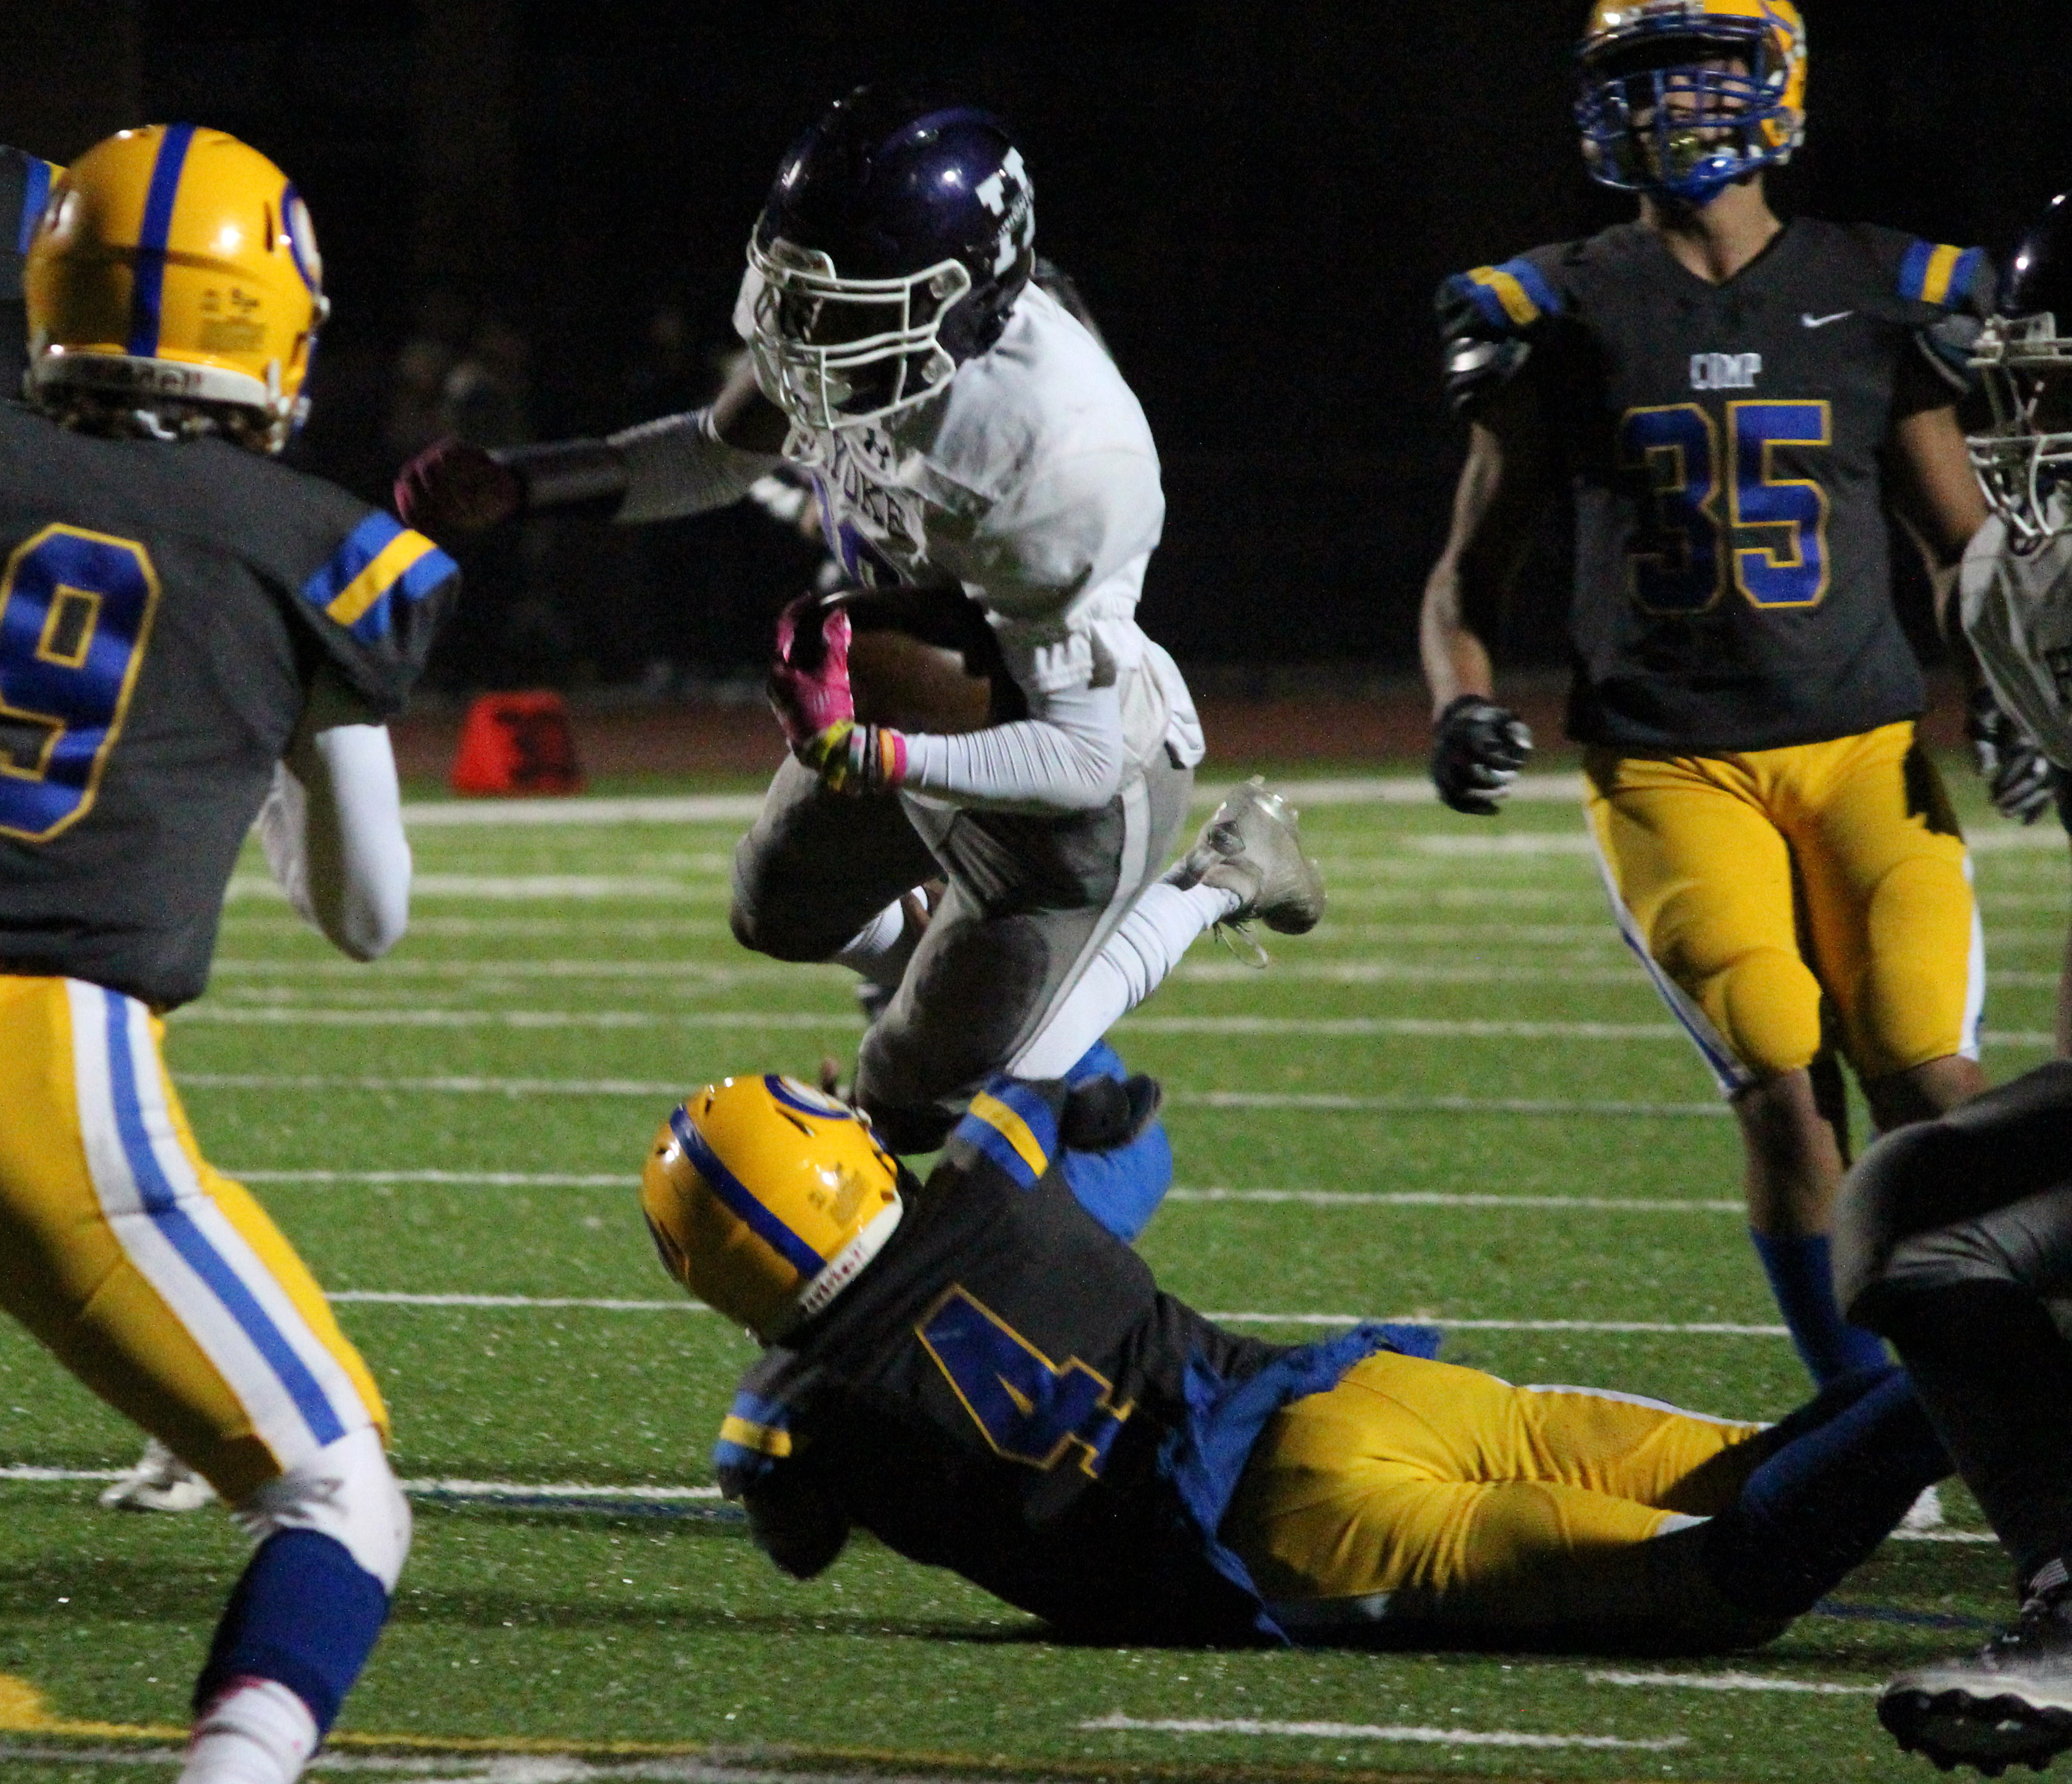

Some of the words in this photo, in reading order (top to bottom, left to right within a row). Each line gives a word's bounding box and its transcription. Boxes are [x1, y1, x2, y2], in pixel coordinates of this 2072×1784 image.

[1690, 352, 1762, 389] COMP
[1618, 399, 1832, 616] 35
[0, 522, 162, 844] 9
[914, 1282, 1136, 1480] 4
